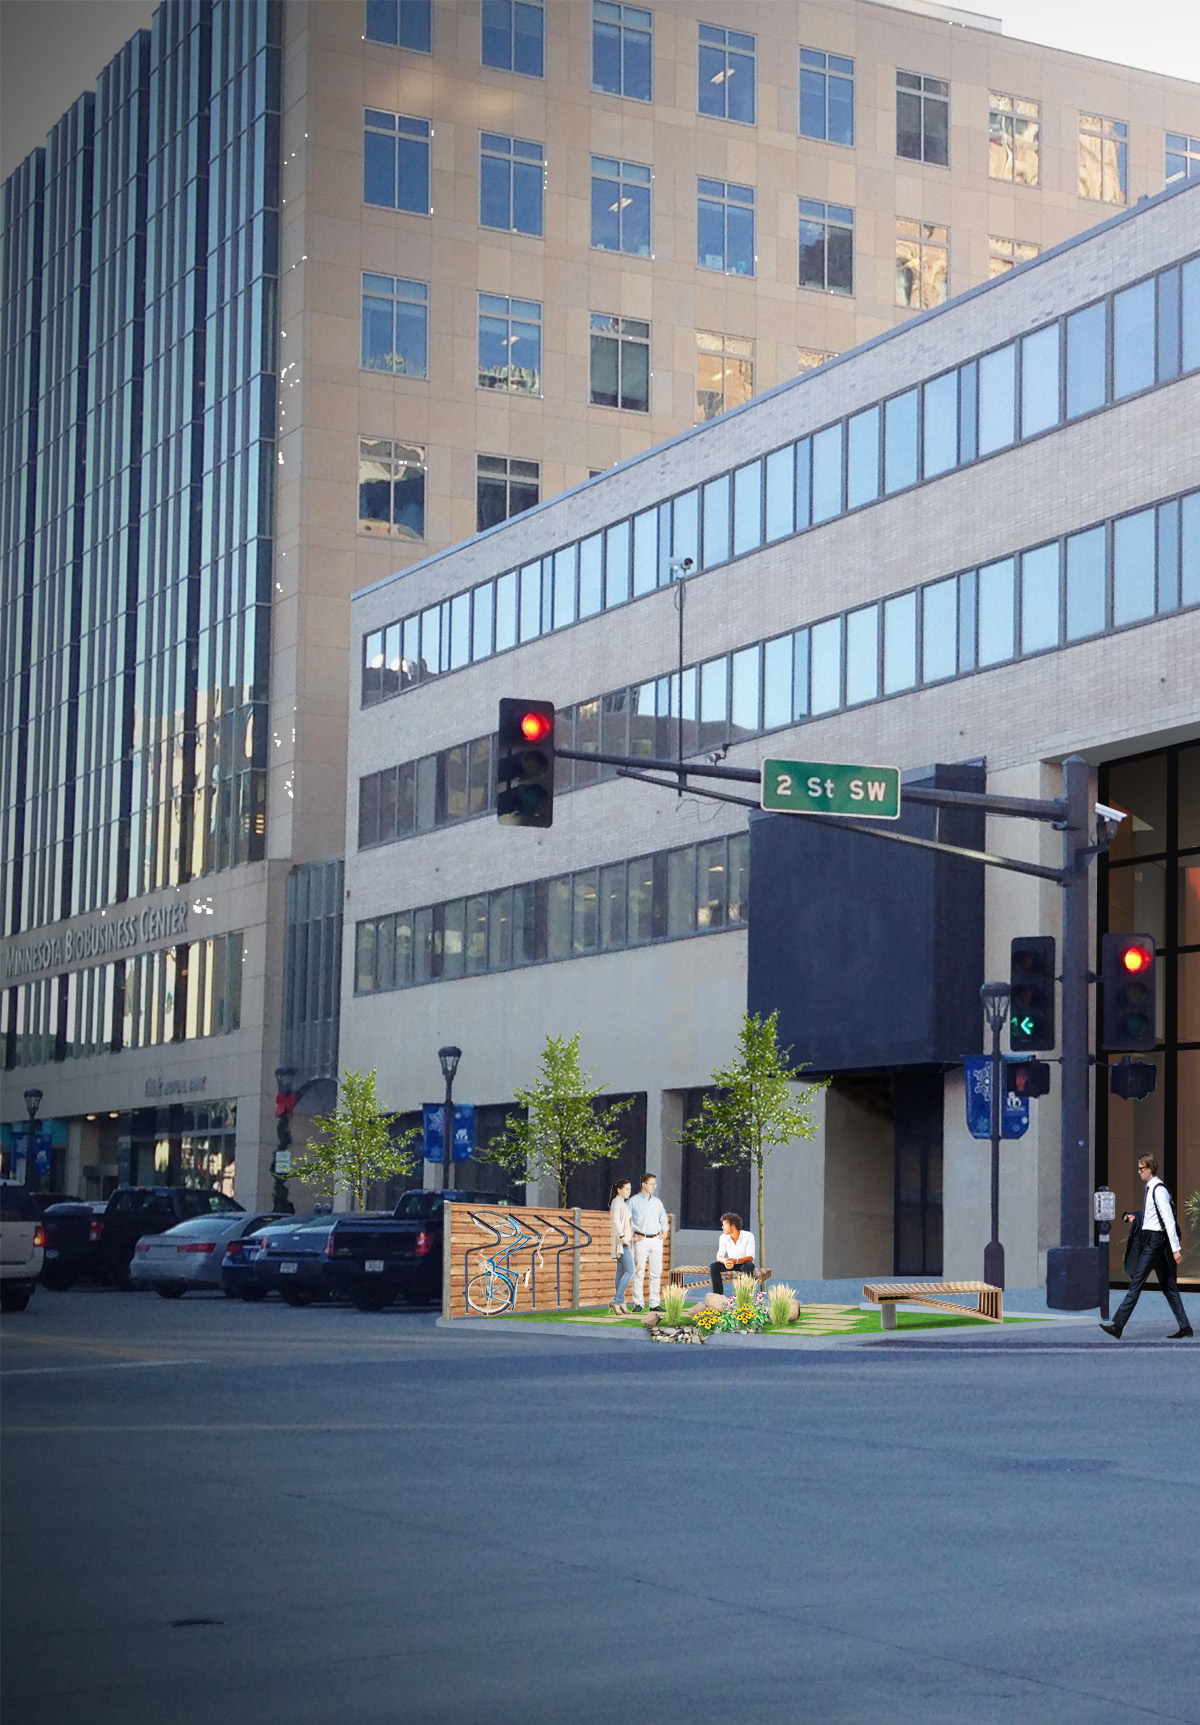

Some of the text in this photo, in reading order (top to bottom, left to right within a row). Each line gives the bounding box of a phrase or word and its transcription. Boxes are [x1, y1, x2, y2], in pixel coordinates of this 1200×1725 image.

[776, 774, 886, 802] 2 St SW
[6, 903, 188, 977] MINNESOTA BIOBUSINESS CENTER
